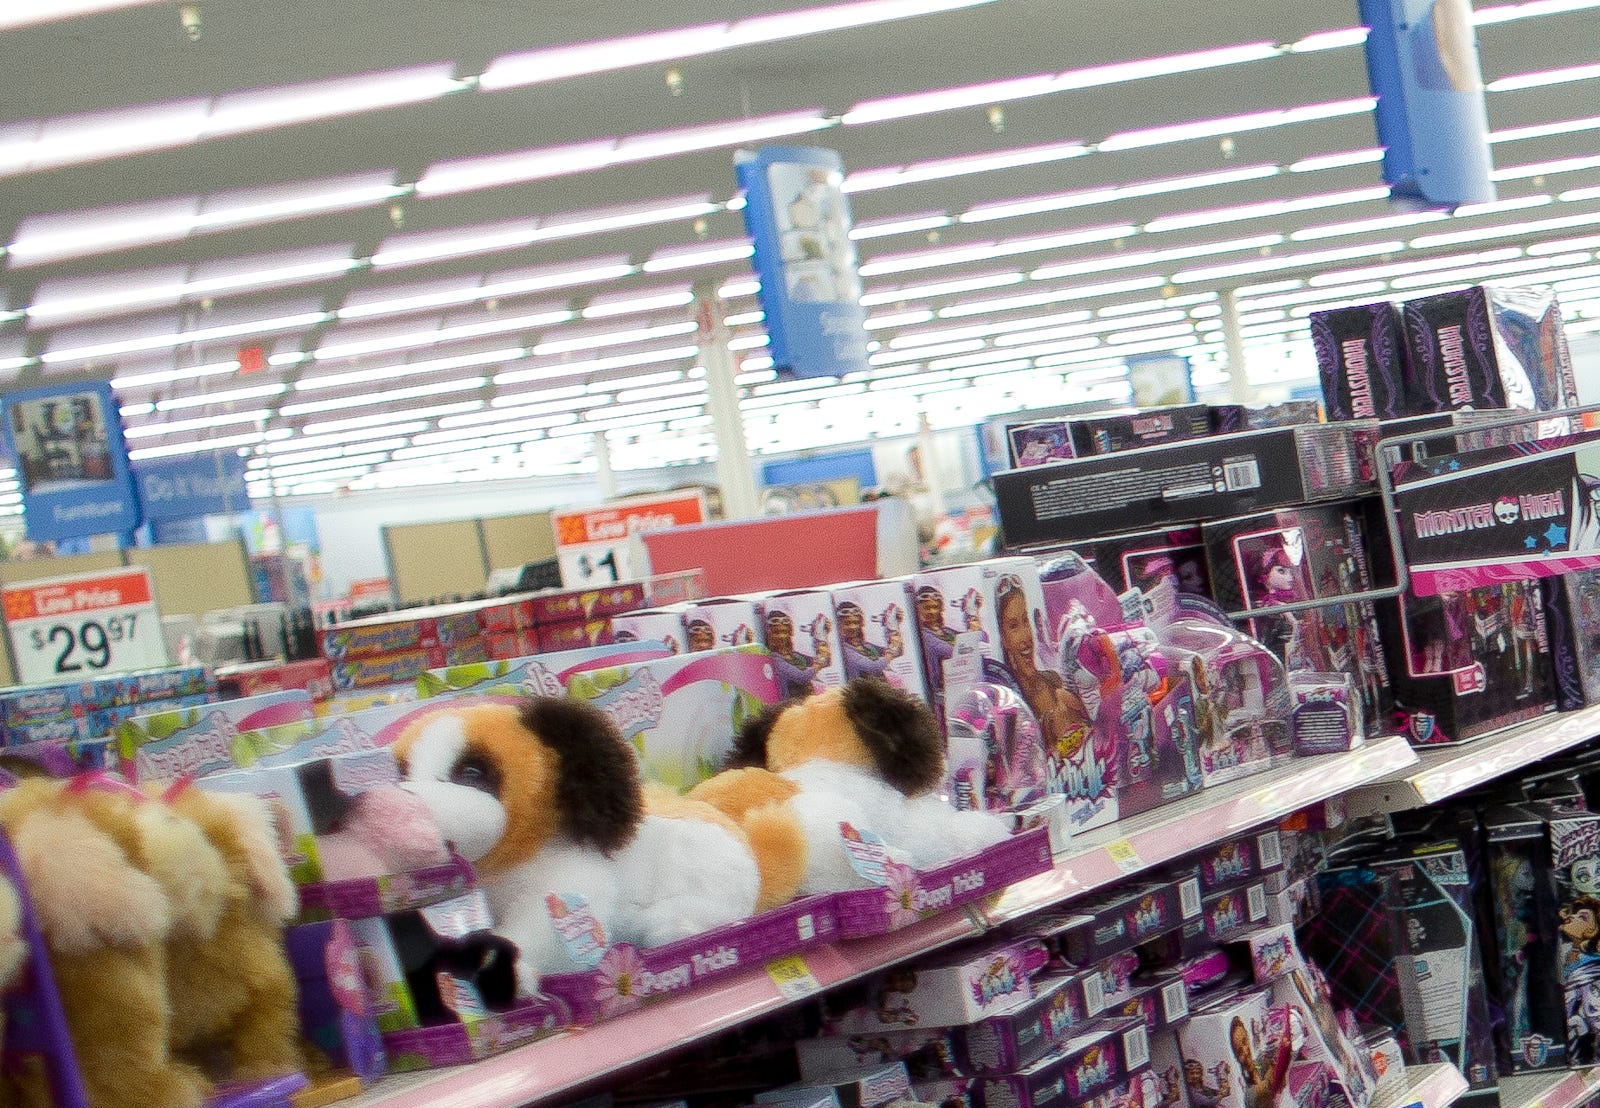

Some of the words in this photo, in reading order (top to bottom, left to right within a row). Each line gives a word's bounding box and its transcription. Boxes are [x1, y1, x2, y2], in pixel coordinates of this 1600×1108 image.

[1342, 338, 1377, 418] MONSTER
[1436, 323, 1474, 405] MONSTER
[1413, 503, 1496, 539] MONSTER
[1519, 490, 1566, 521] HIGH
[35, 591, 73, 614] Low
[75, 588, 121, 607] Price
